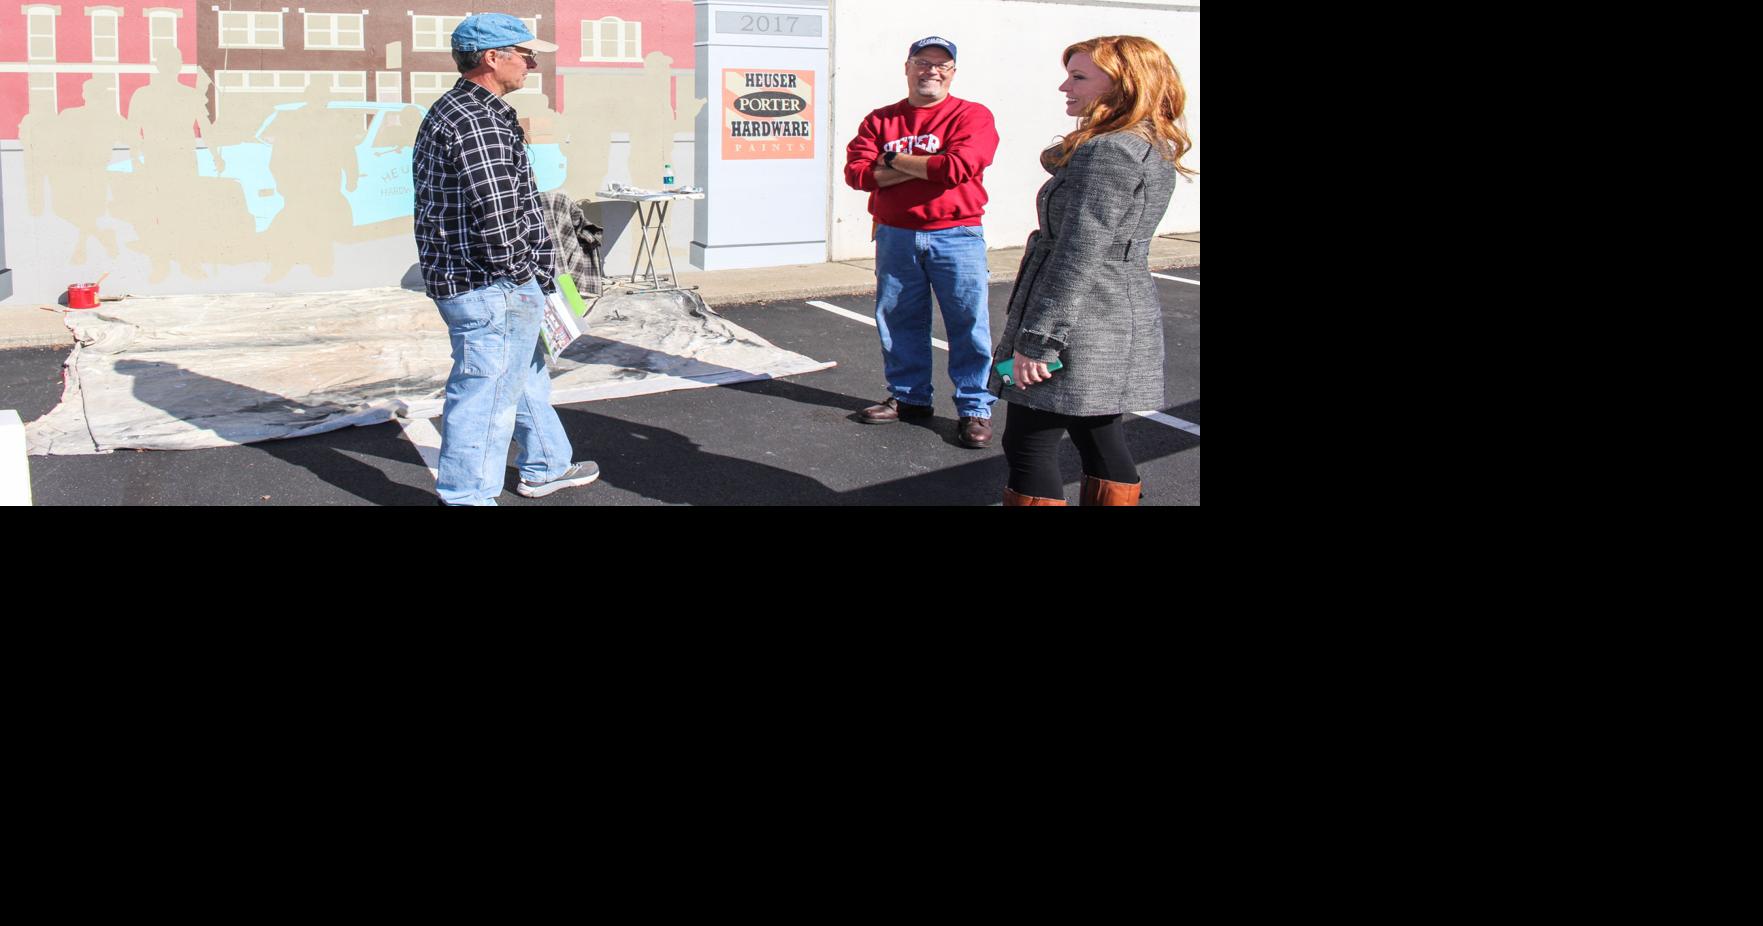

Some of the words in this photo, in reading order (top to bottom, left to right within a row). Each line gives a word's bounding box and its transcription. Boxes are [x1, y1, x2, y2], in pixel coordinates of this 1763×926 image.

[740, 15, 799, 33] 2017
[745, 73, 797, 88] HEUSER
[739, 98, 801, 111] PORTER
[731, 121, 809, 137] HARDWARE
[735, 143, 807, 152] PAINTS
[382, 165, 410, 182] HEU
